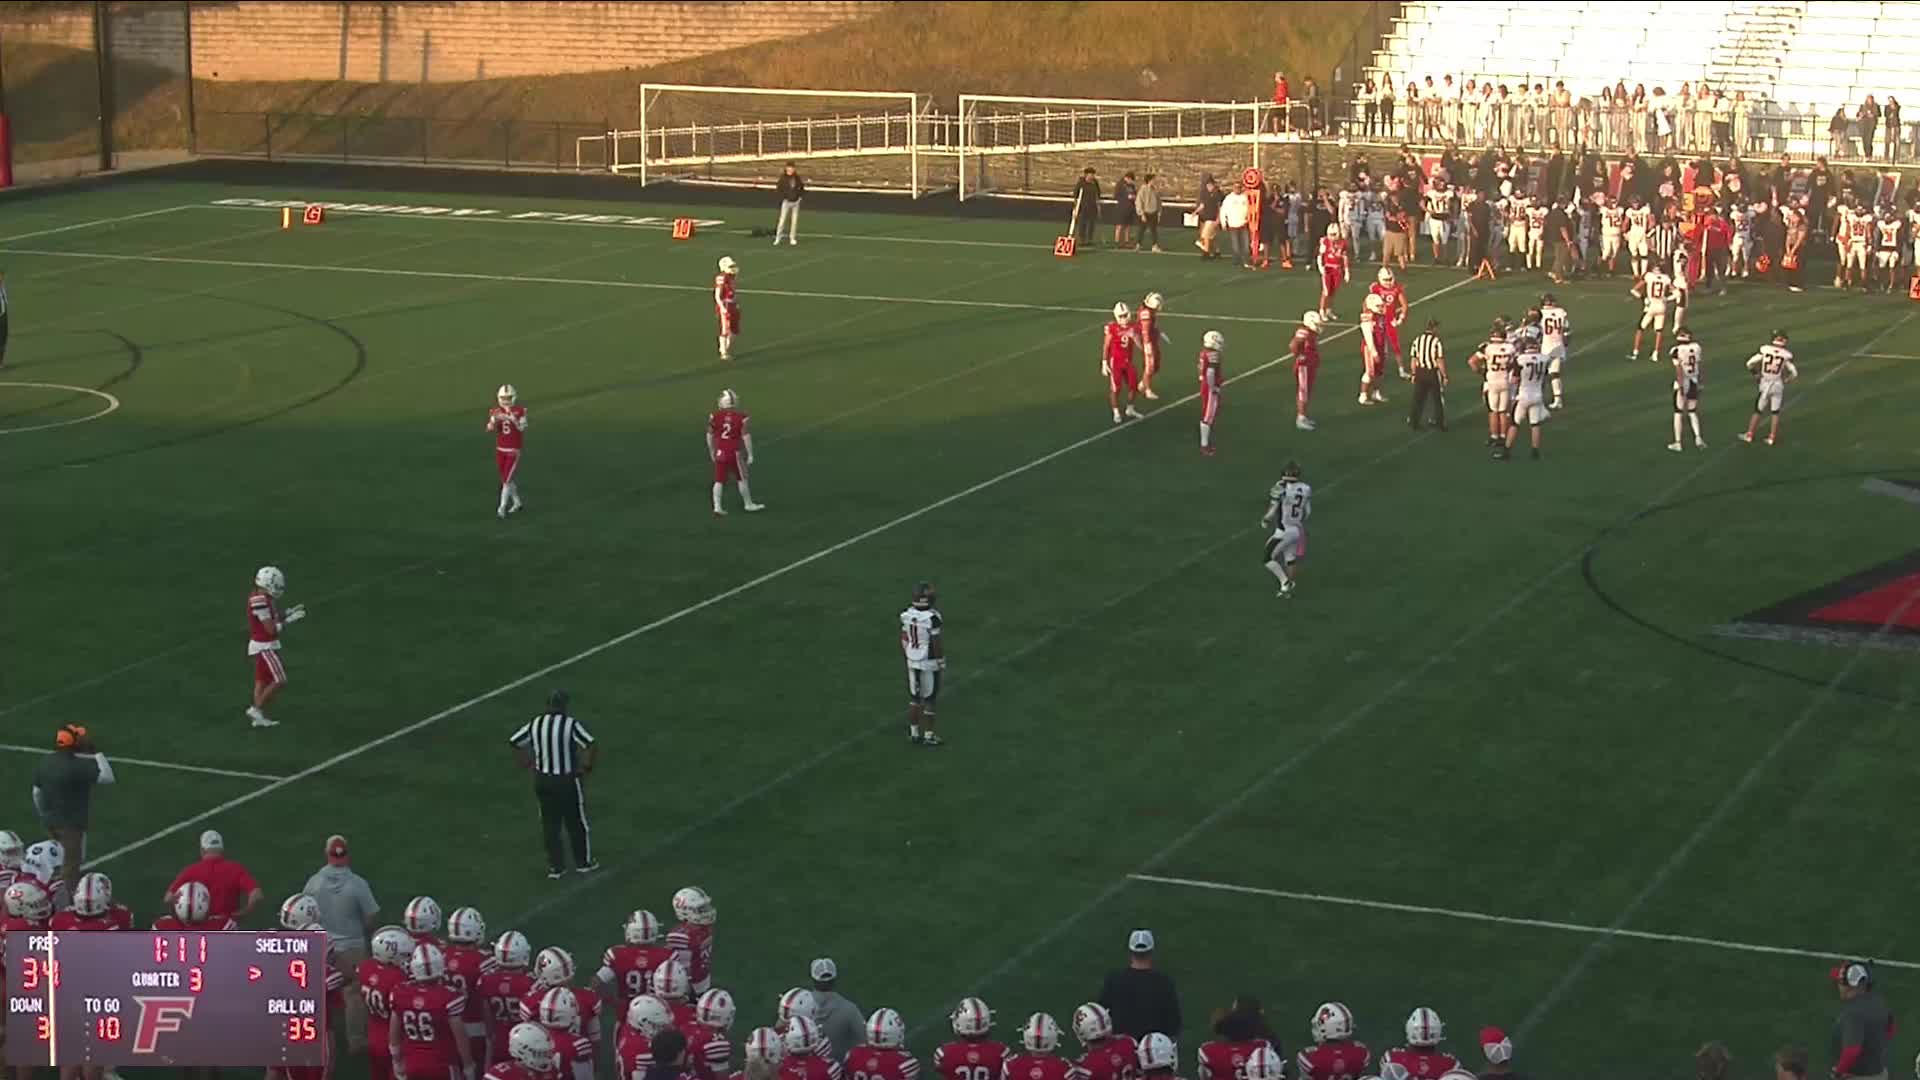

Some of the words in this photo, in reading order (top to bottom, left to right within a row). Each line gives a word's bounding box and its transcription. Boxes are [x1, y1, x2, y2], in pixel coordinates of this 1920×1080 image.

[307, 207, 320, 220] G
[1056, 238, 1072, 254] 20
[1651, 281, 1663, 298] 13
[1544, 317, 1562, 335] 64
[1120, 335, 1129, 348] 9
[1526, 361, 1543, 381] 74
[1764, 353, 1785, 374] 23
[721, 423, 732, 440] 2
[1291, 494, 1303, 519] 2
[909, 623, 920, 649] 11
[361, 985, 389, 1019] 70
[403, 1010, 435, 1042] 66
